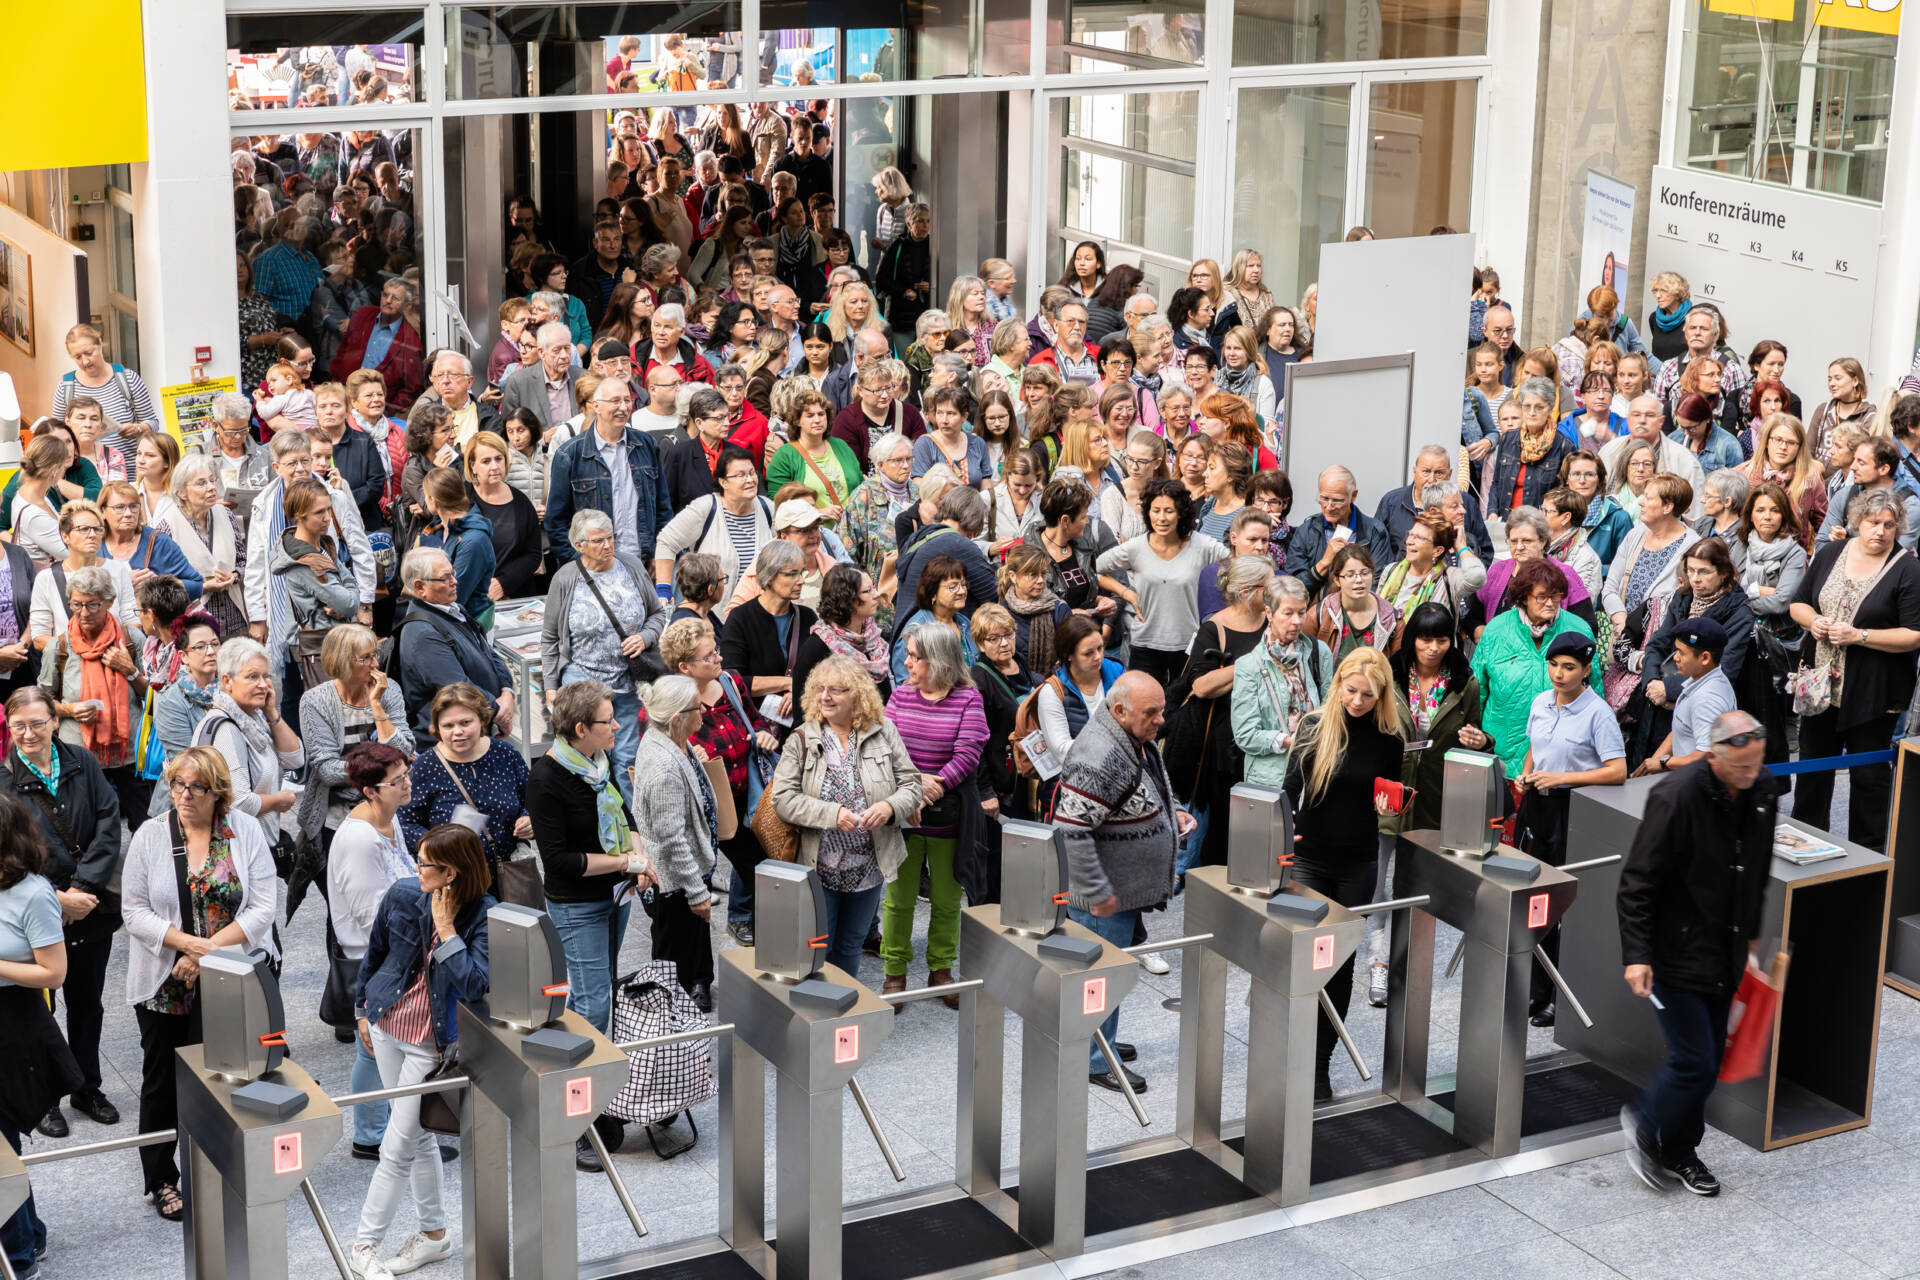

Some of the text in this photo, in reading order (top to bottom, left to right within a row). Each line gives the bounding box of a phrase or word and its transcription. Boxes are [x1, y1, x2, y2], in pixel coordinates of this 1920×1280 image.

[1660, 186, 1786, 229] Konferenzräume
[1667, 223, 1848, 272] K1 K2 K3 K4 K5
[1704, 283, 1716, 295] K7
